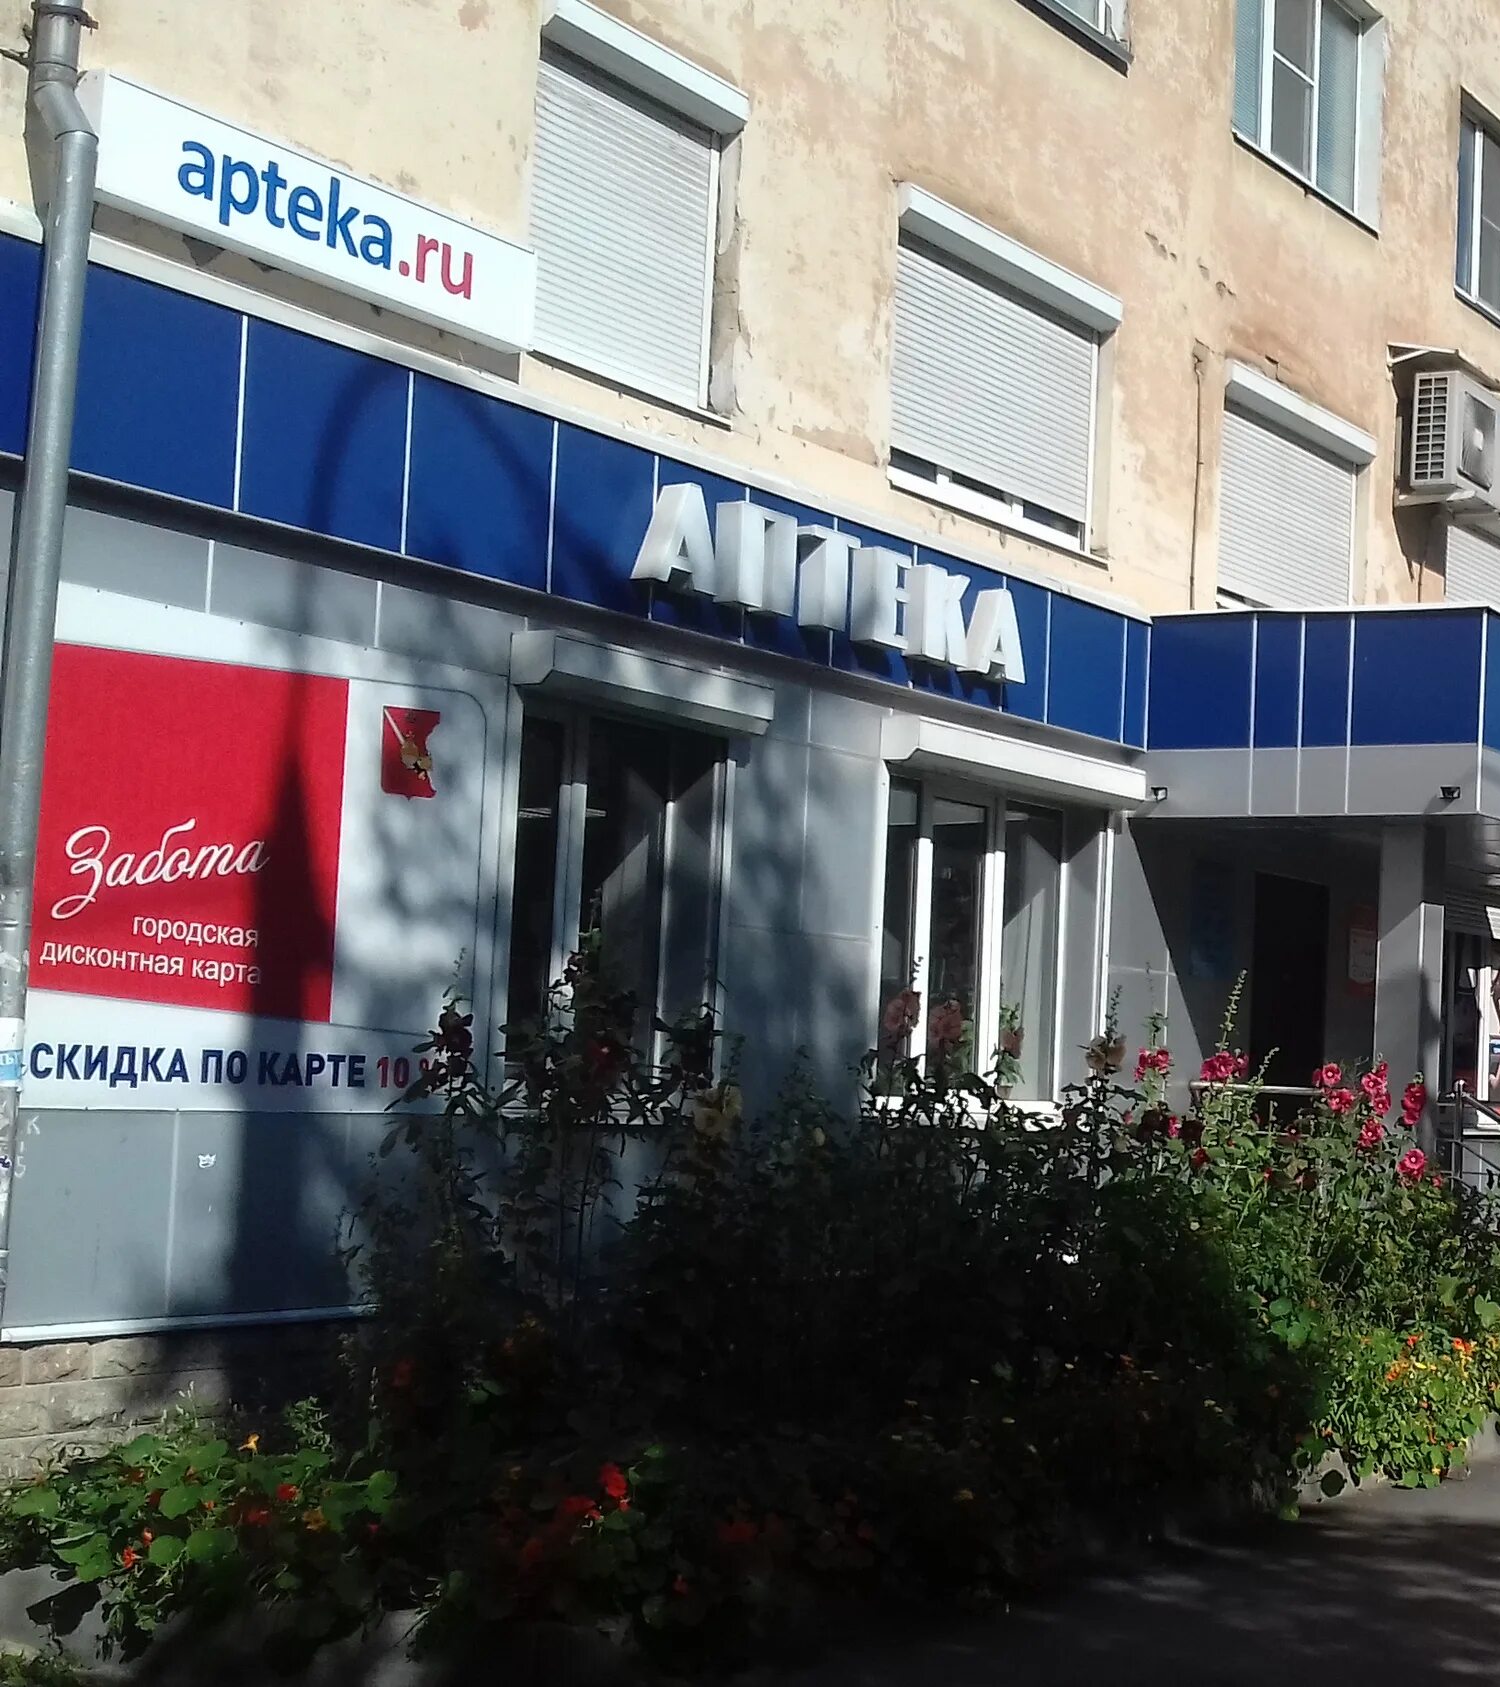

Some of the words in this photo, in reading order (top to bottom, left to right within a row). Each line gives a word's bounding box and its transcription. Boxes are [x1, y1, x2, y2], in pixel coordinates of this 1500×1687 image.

[177, 140, 474, 301] apteka.ru
[630, 482, 1027, 685] АПТЕКА
[51, 818, 271, 919] Забота
[39, 940, 184, 976] дисконтная
[191, 957, 261, 988] карта
[132, 915, 258, 948] городская
[30, 1042, 189, 1088] СКИДКА
[200, 1049, 247, 1085] ПО
[257, 1052, 366, 1088] КАРТЕ
[376, 1056, 410, 1089] 10
